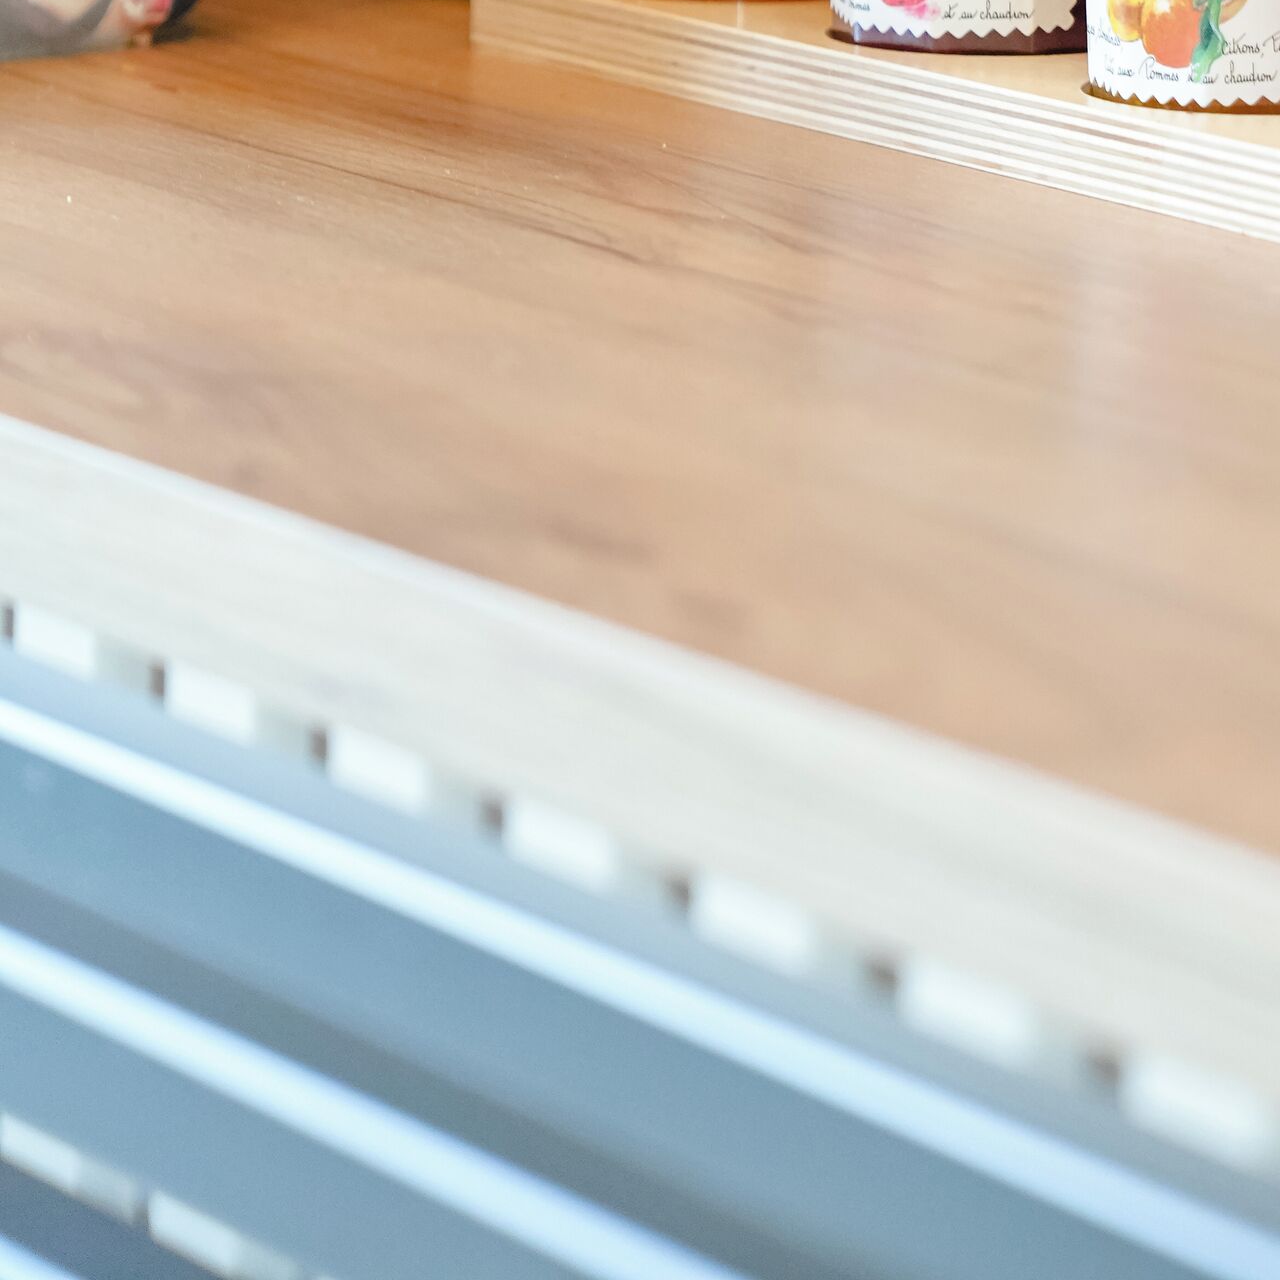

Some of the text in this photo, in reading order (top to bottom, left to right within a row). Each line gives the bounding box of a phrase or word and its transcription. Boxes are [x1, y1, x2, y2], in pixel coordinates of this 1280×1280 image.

[979, 0, 1035, 21] chaudron
[1221, 33, 1264, 58] Citrons,
[1138, 56, 1179, 81] Pommes
[1224, 60, 1278, 86] chaudron
